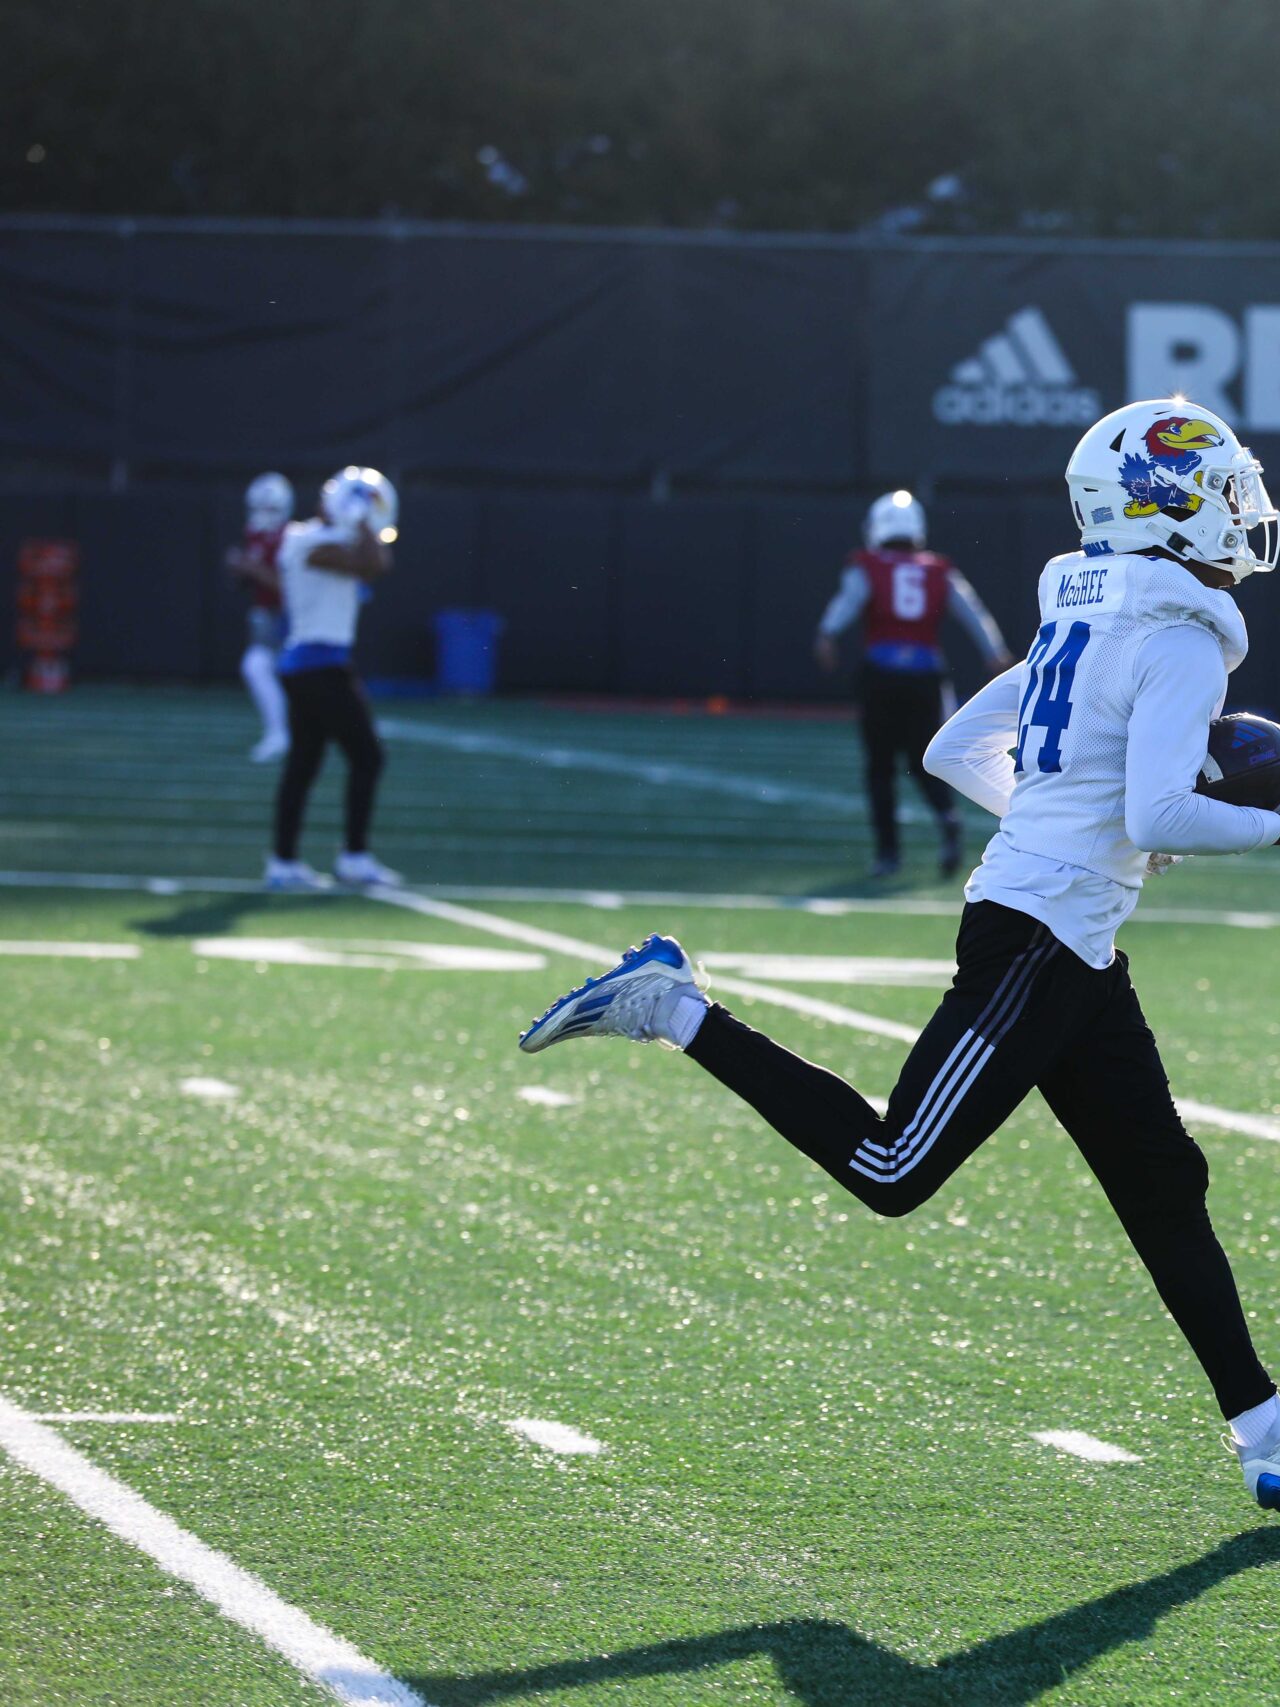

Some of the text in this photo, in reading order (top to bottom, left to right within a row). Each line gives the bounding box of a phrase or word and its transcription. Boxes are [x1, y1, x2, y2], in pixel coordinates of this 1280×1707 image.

[932, 380, 1100, 428] adidas
[891, 562, 927, 621] 6
[1056, 569, 1109, 608] McGHEE
